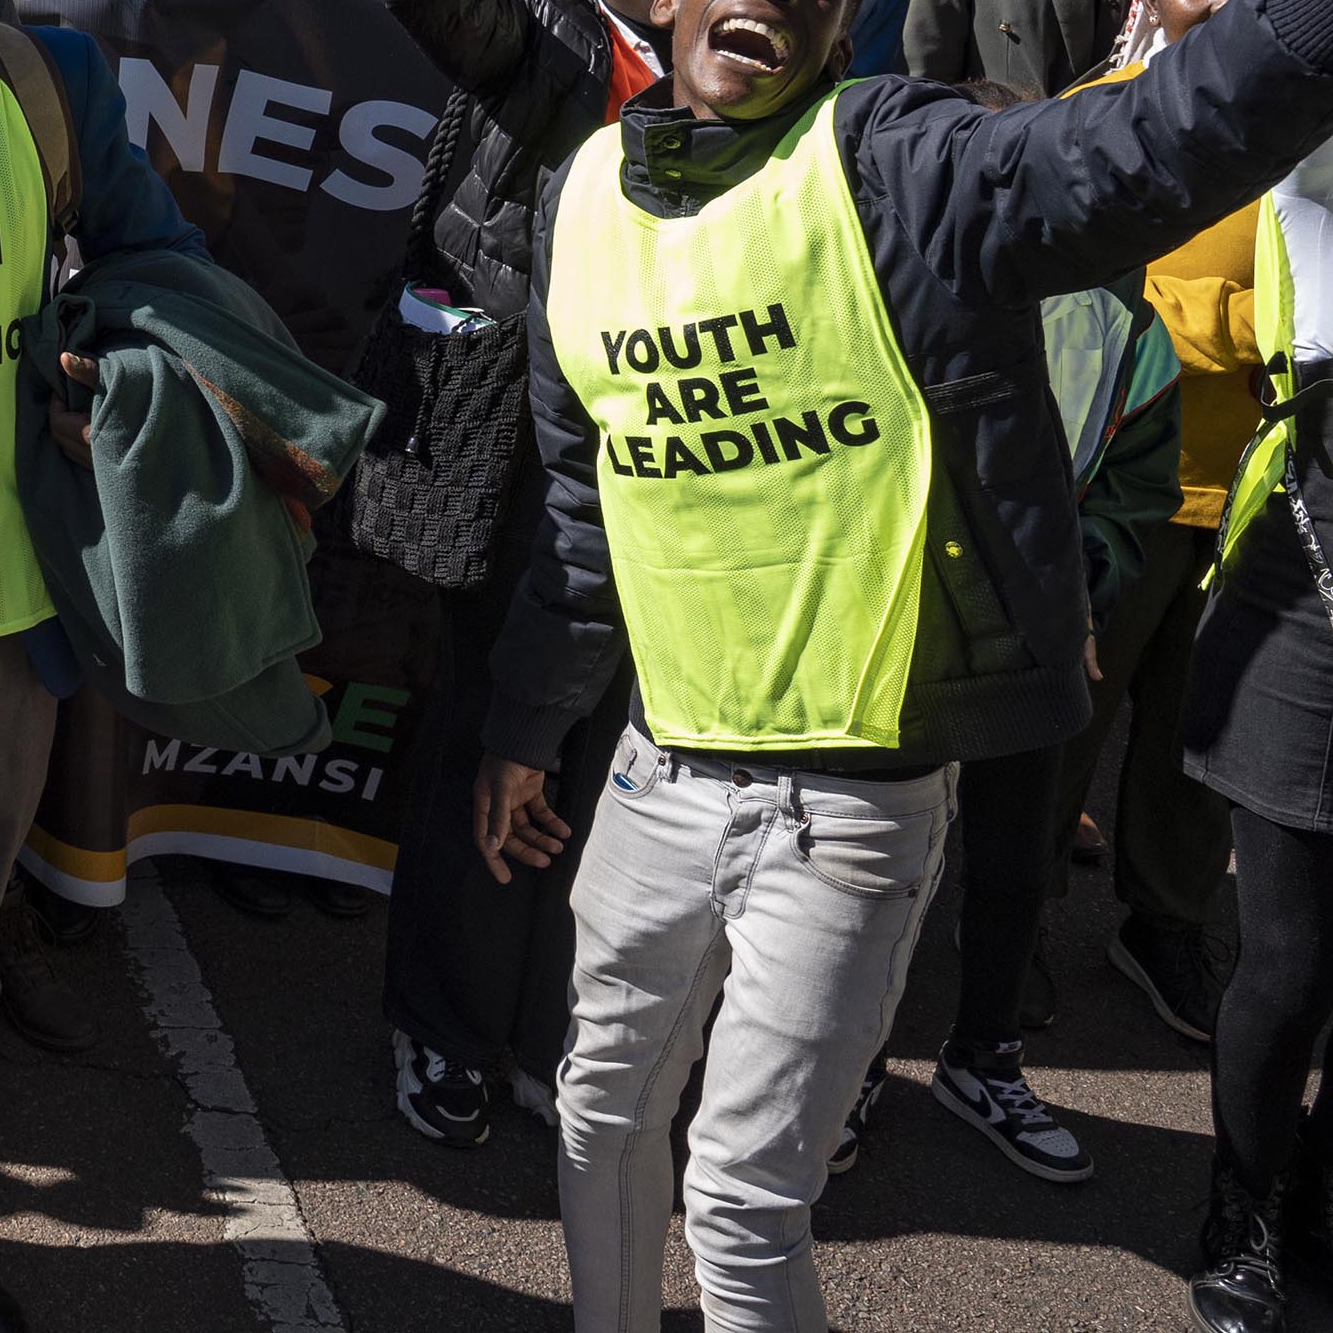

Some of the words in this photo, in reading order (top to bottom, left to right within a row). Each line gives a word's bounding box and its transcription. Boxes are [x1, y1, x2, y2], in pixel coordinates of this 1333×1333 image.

[601, 303, 798, 375] YOUTH
[646, 367, 770, 426] ARE
[607, 401, 881, 480] LEADING
[142, 738, 385, 803] MZANSI
